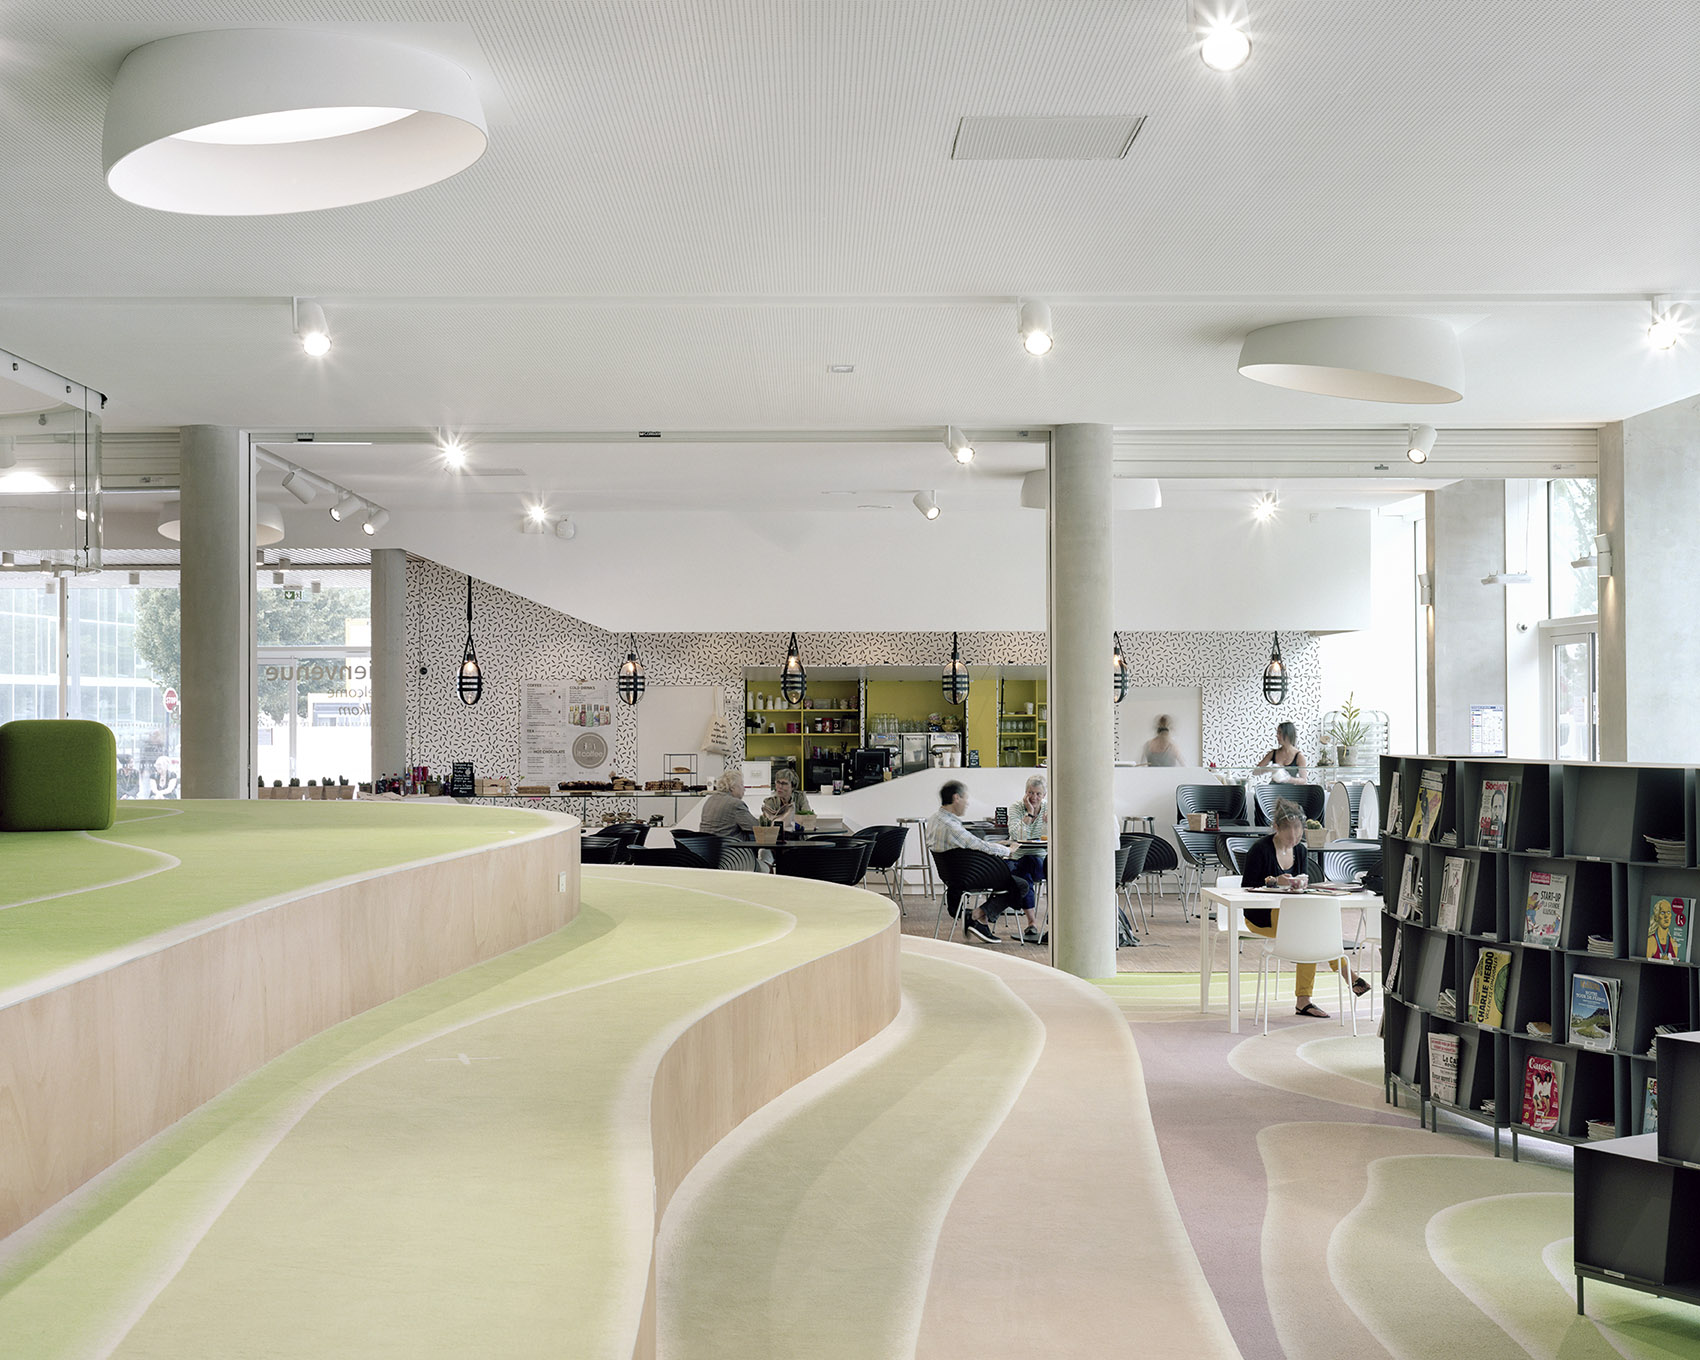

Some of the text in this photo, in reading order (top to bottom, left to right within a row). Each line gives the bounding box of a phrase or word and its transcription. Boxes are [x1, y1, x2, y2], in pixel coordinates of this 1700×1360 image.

[1485, 781, 1507, 793] Society
[1483, 951, 1495, 983] HEBDO
[1477, 985, 1490, 1023] CHARLIE
